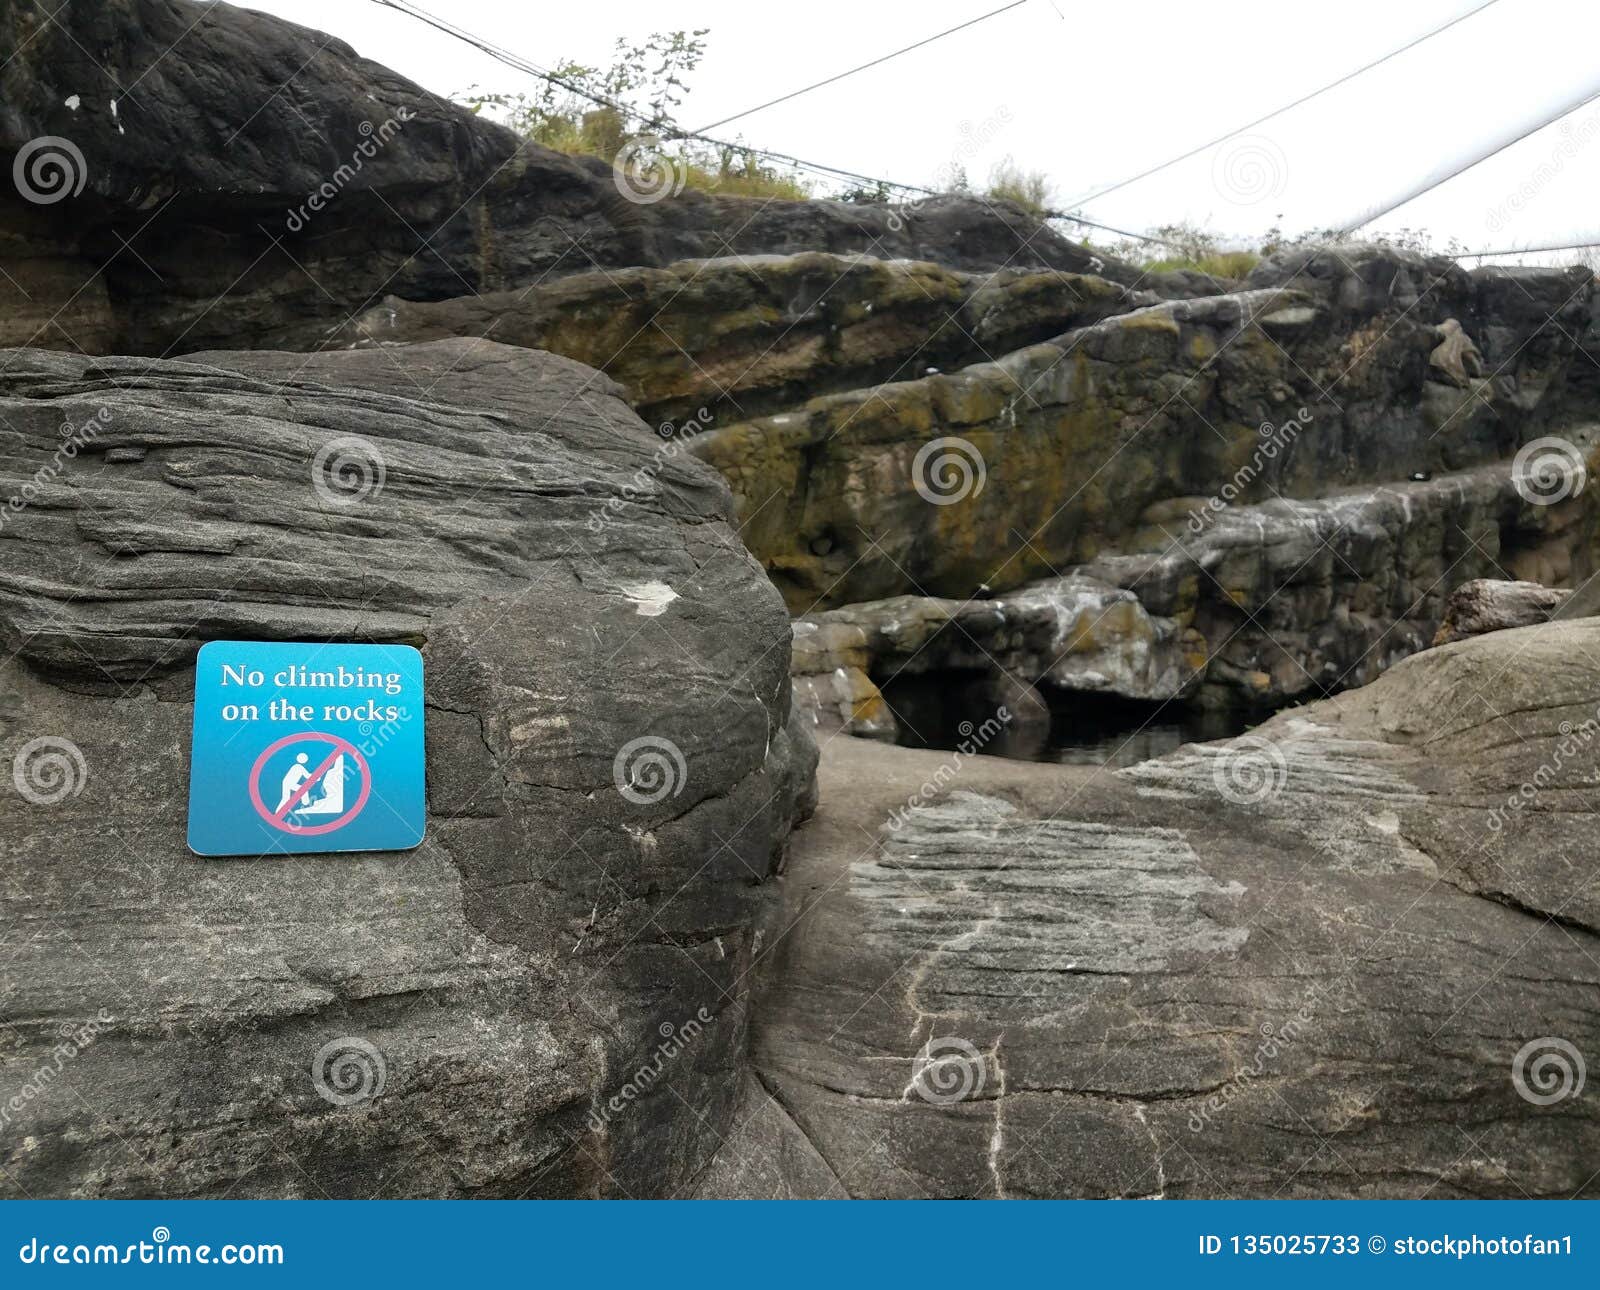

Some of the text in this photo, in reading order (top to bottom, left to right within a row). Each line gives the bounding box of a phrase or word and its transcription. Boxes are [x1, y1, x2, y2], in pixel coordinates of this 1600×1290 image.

[221, 663, 402, 695] No climbing
[221, 698, 400, 722] on the rocks
